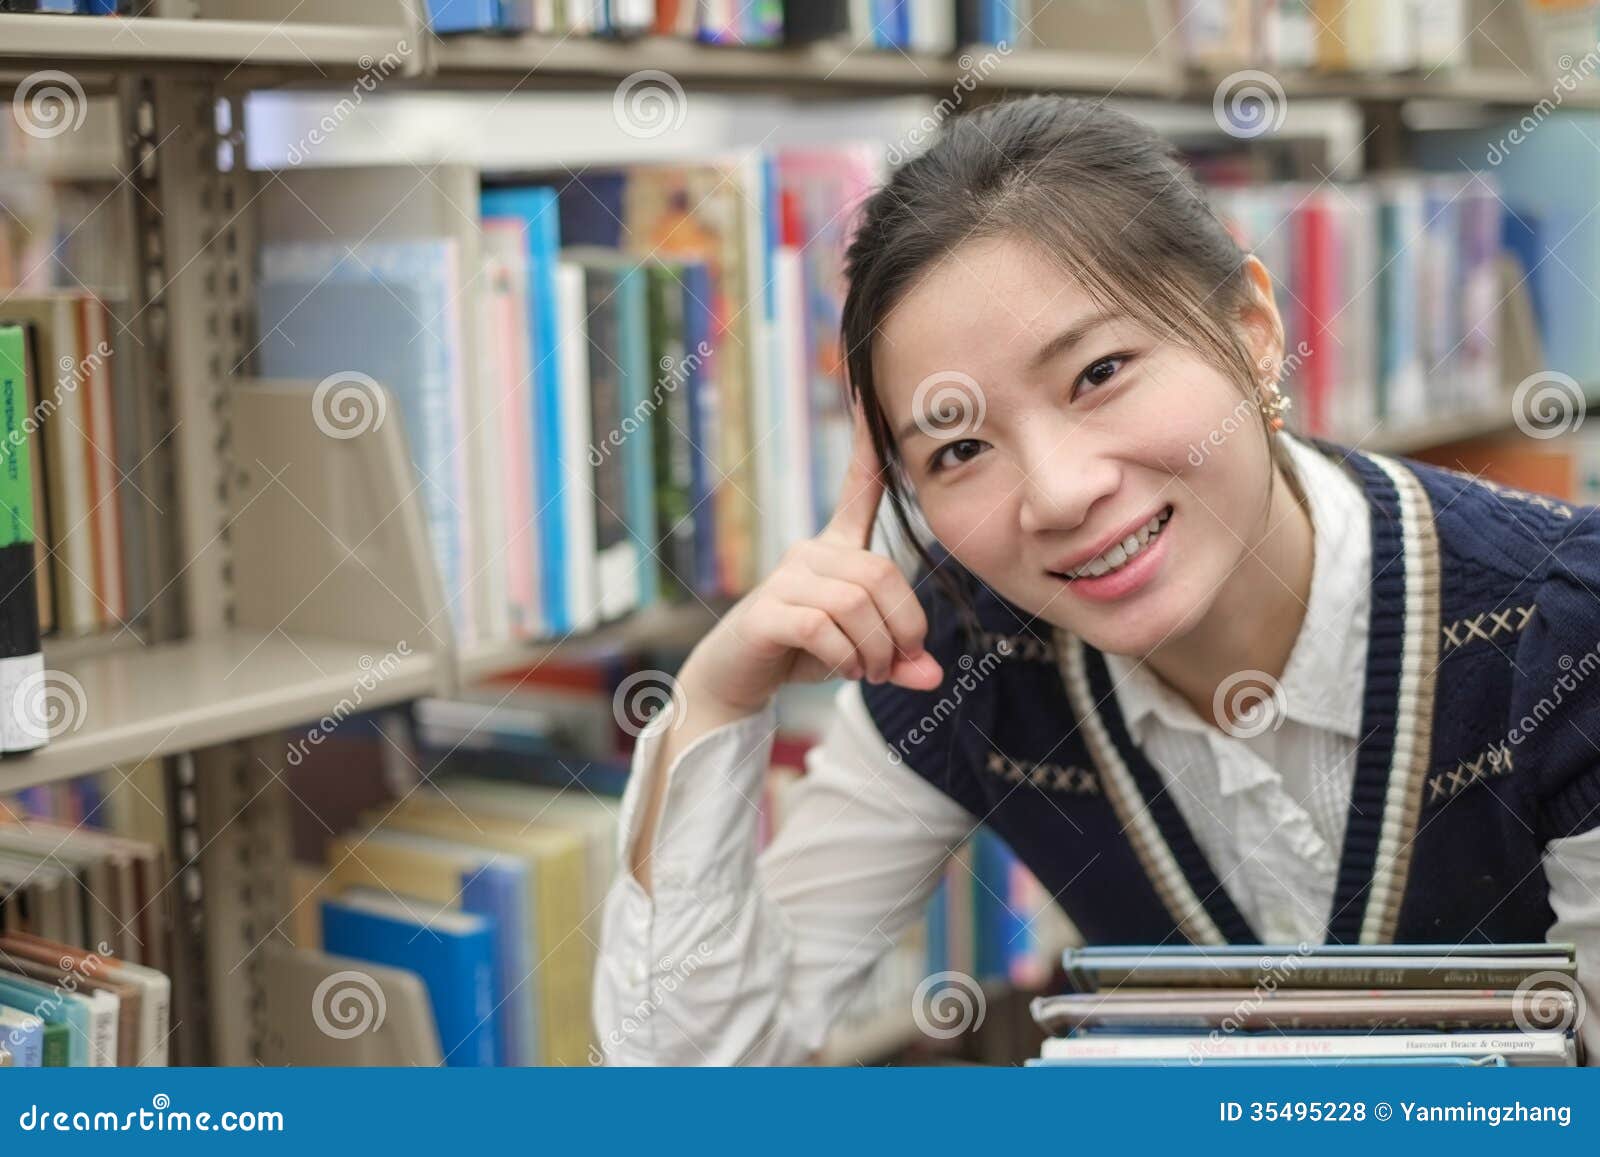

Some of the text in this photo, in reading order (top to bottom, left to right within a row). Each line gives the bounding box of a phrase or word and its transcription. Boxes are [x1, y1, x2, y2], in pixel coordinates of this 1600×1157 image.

[1406, 1040, 1536, 1050] Harcourt Brace & Company
